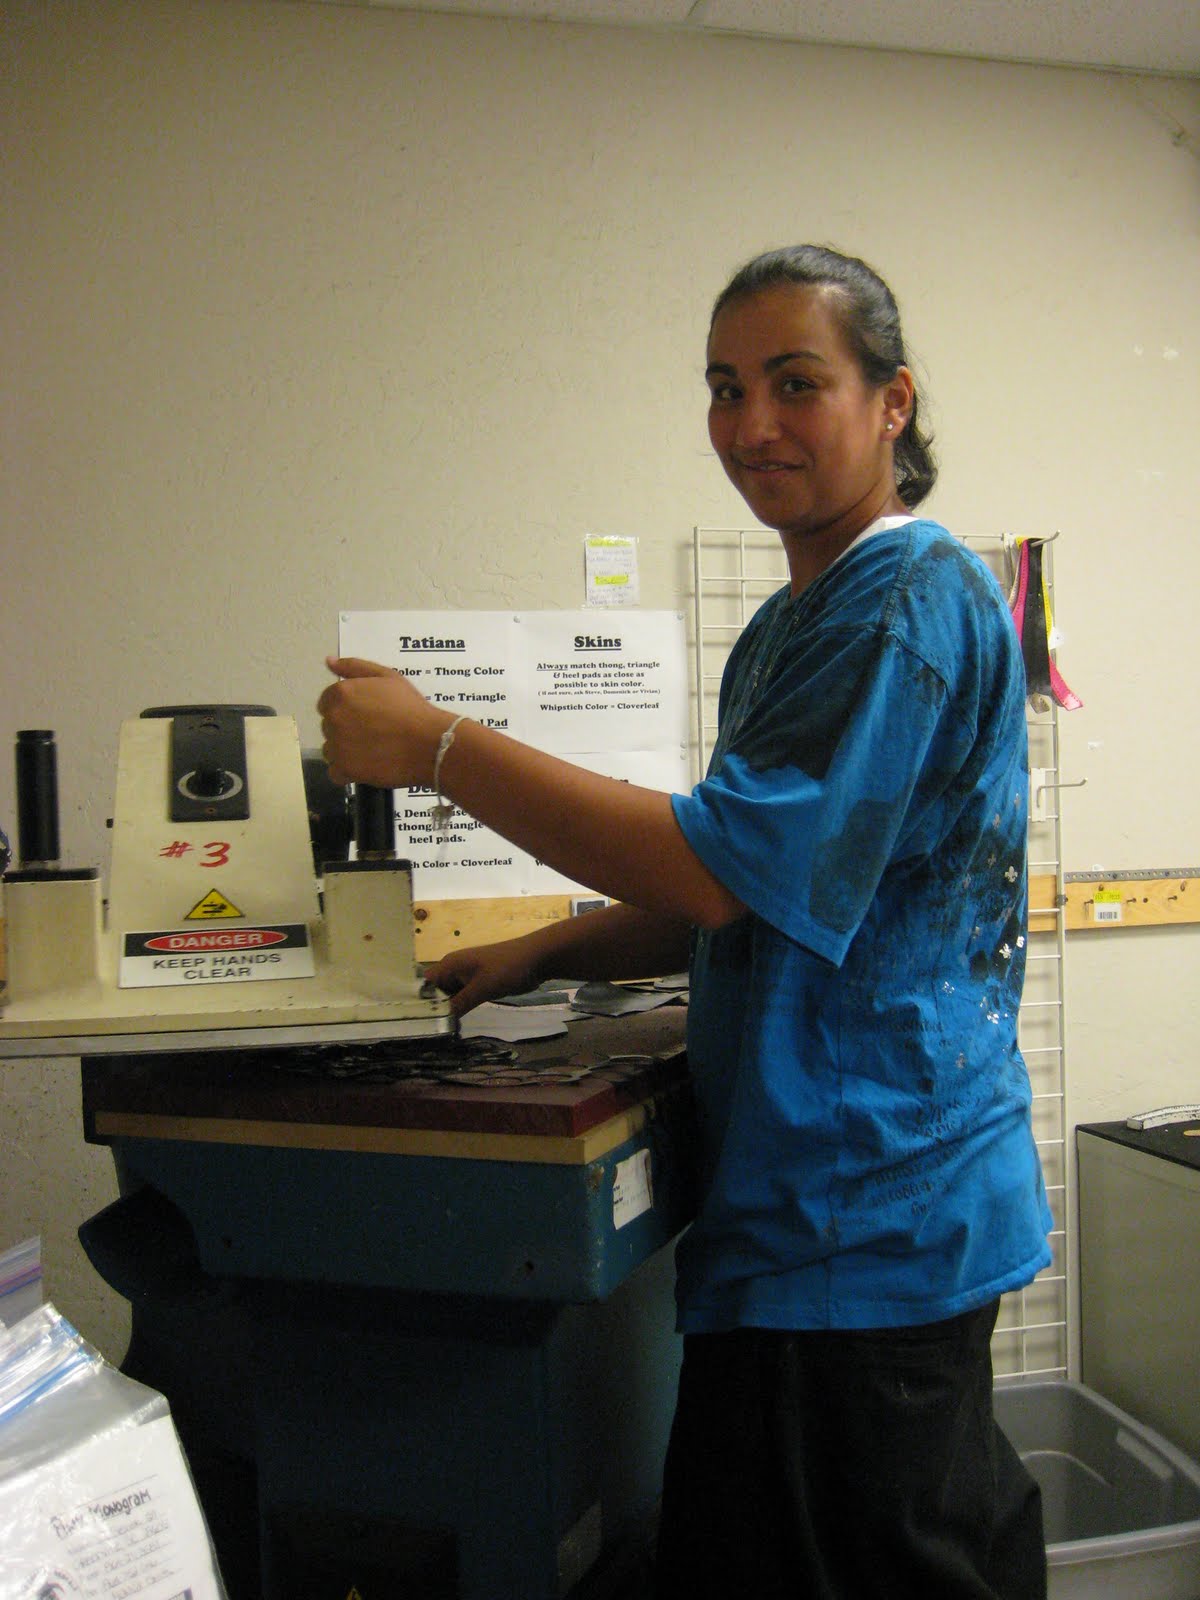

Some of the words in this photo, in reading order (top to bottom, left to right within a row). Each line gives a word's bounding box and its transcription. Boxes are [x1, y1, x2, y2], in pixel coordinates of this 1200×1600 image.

[399, 636, 466, 649] Tatiana
[574, 636, 622, 648] Skins
[598, 662, 626, 670] thong,
[627, 661, 660, 669] triangle
[434, 667, 471, 677] Thong
[473, 667, 505, 676] Color
[581, 672, 601, 680] pads
[554, 681, 588, 689] possible
[620, 680, 645, 688] color.
[434, 693, 455, 702] Toe
[458, 693, 506, 703] Triangle
[540, 704, 583, 712] Whipstich
[487, 718, 508, 727] Pad
[409, 835, 433, 844] heel
[436, 835, 466, 845] pads.
[200, 842, 231, 868] 3
[422, 861, 450, 869] Color
[461, 858, 513, 867] Cloverleaf
[169, 932, 263, 949] DANGER
[153, 958, 206, 970] KEEP
[212, 953, 282, 967] HANDS
[183, 967, 252, 980] CLEAR
